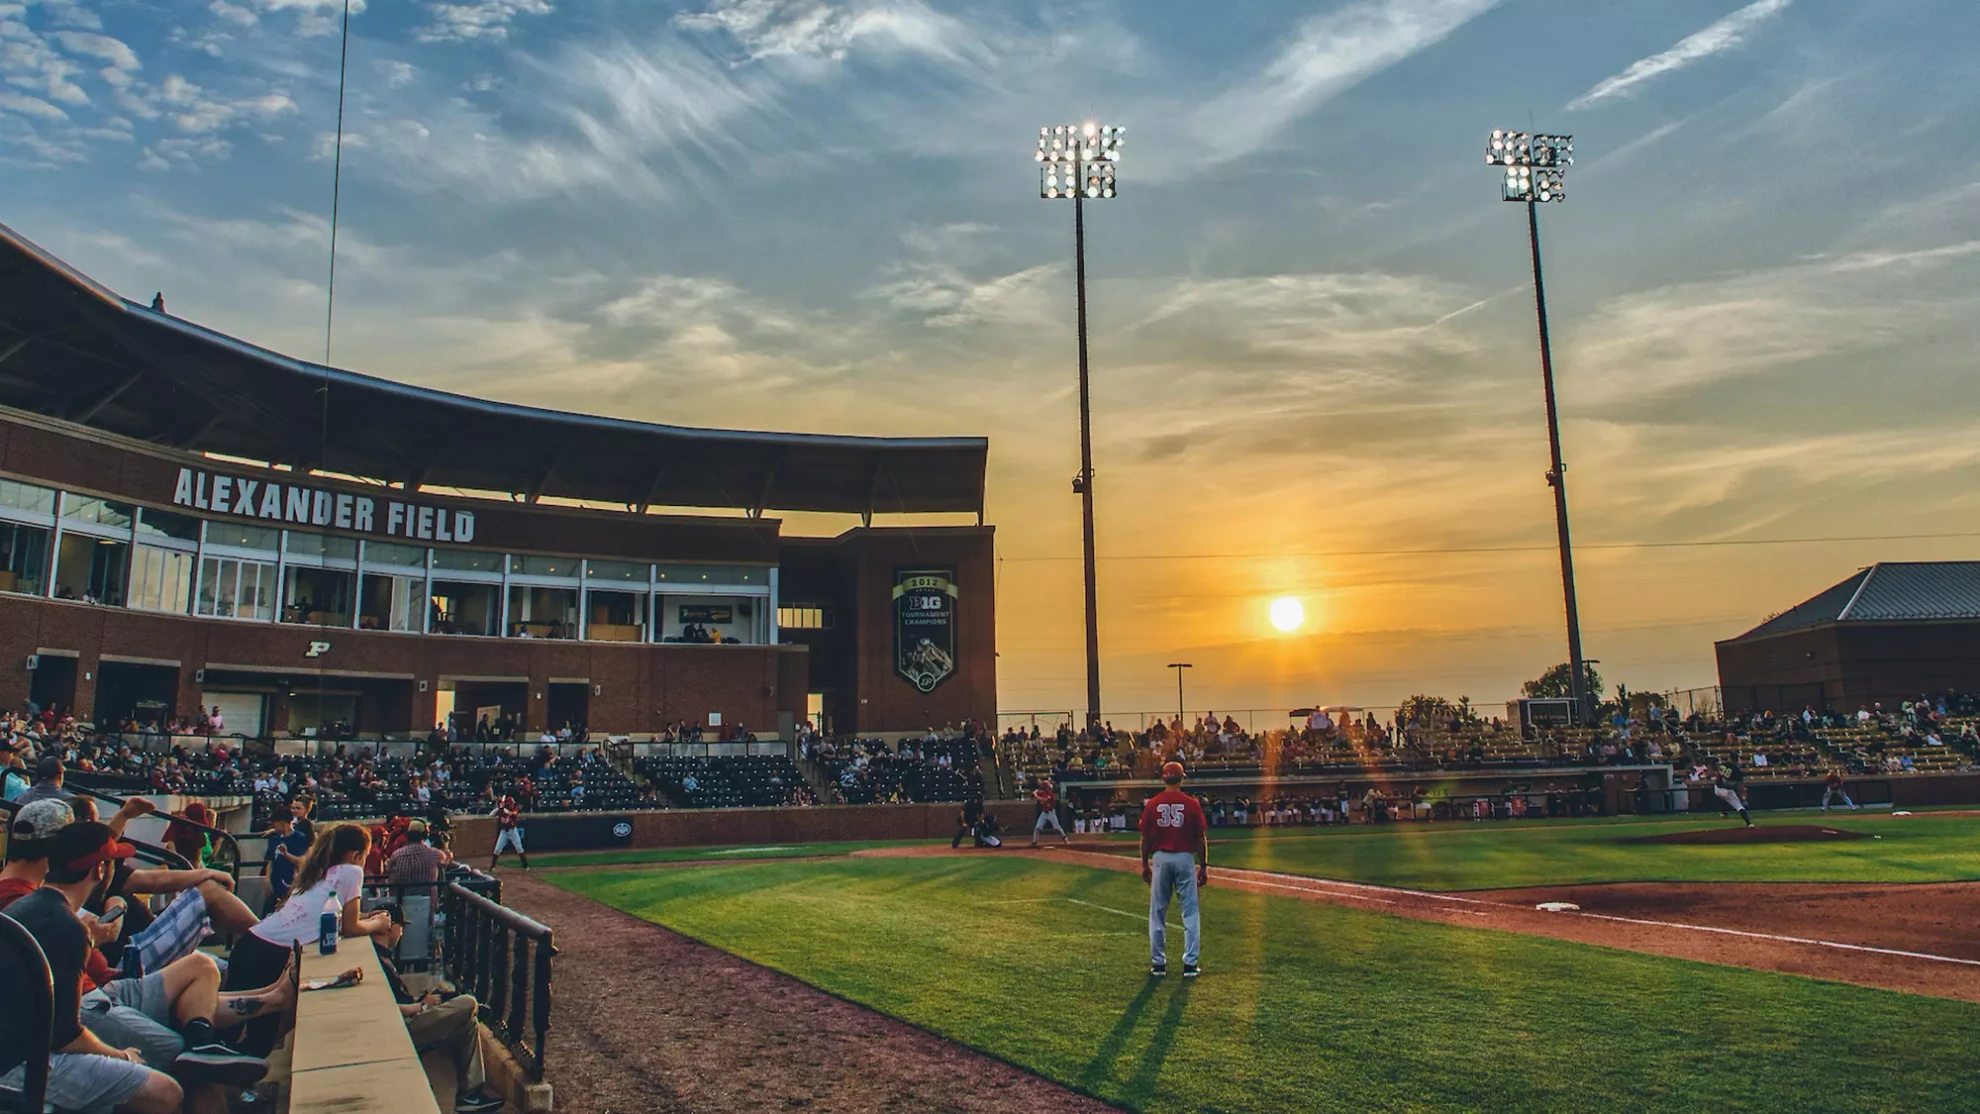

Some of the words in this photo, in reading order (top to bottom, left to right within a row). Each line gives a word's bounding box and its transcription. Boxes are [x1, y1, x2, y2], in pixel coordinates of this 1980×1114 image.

[174, 468, 374, 532] ALEXANDER
[387, 502, 475, 543] FIELD
[911, 578, 938, 587] 2012
[305, 641, 331, 657] P
[1156, 803, 1185, 828] 35
